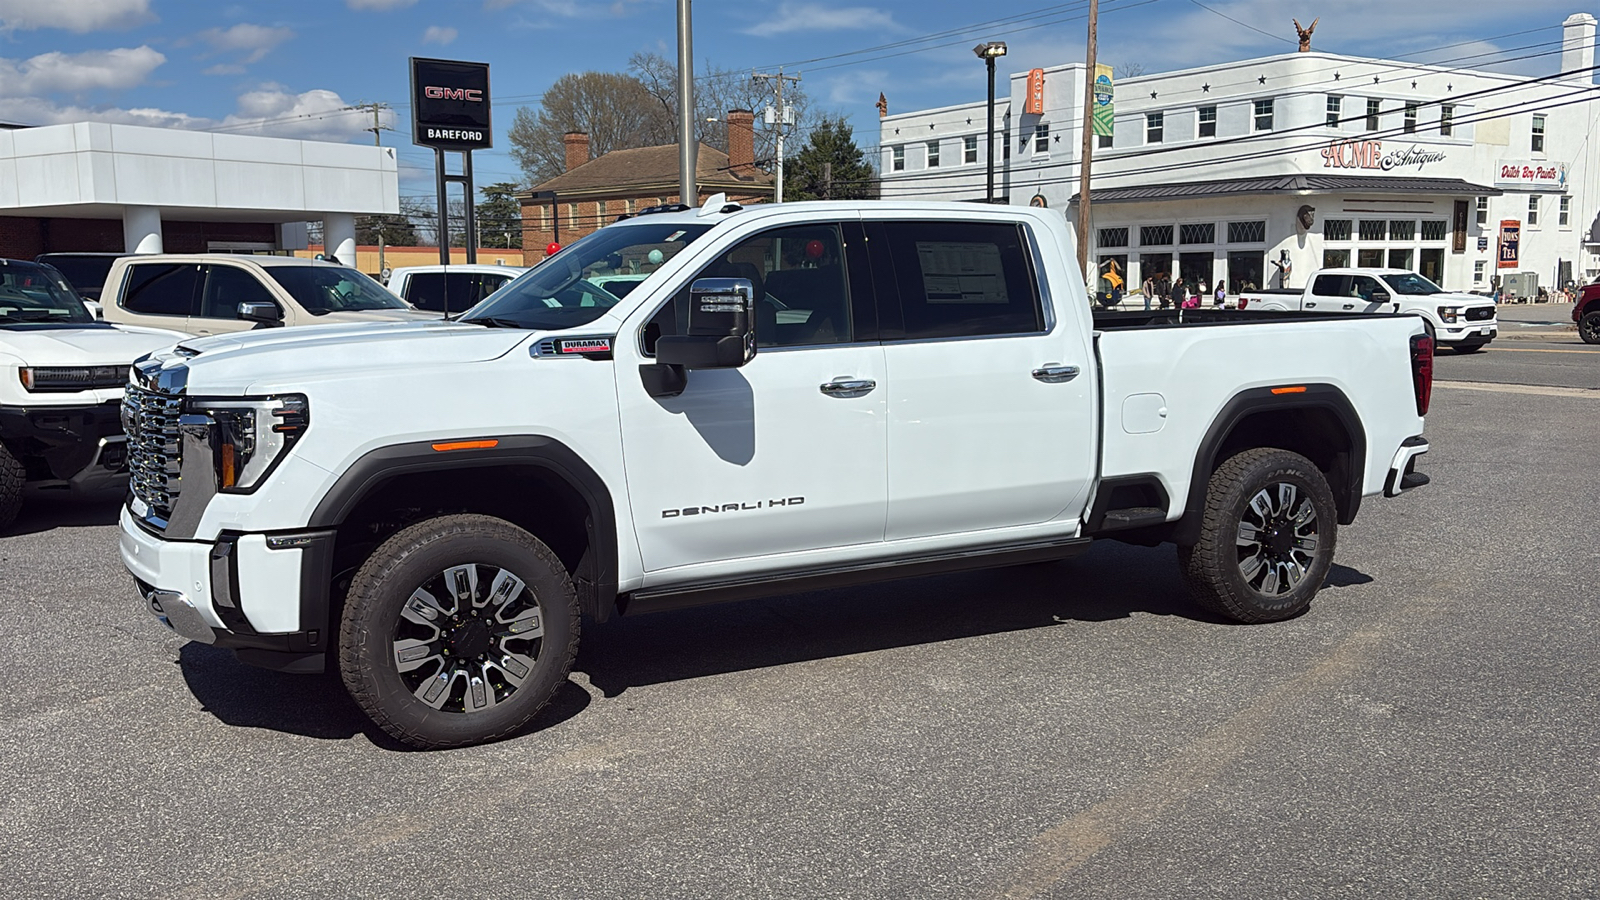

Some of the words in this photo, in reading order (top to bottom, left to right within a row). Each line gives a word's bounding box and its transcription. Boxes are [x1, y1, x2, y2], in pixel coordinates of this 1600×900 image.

[425, 86, 482, 102] GMC
[1034, 71, 1042, 112] ACME
[428, 128, 482, 141] BAREFORD
[1321, 138, 1382, 169] ACME
[1381, 143, 1447, 171] Antiques
[1501, 164, 1520, 179] Dutch
[1522, 165, 1535, 181] Boy
[1535, 165, 1557, 180] Paints
[1502, 246, 1516, 259] TEA
[564, 340, 607, 349] DURAMAX
[661, 500, 762, 519] DENALI
[768, 496, 805, 508] HD
